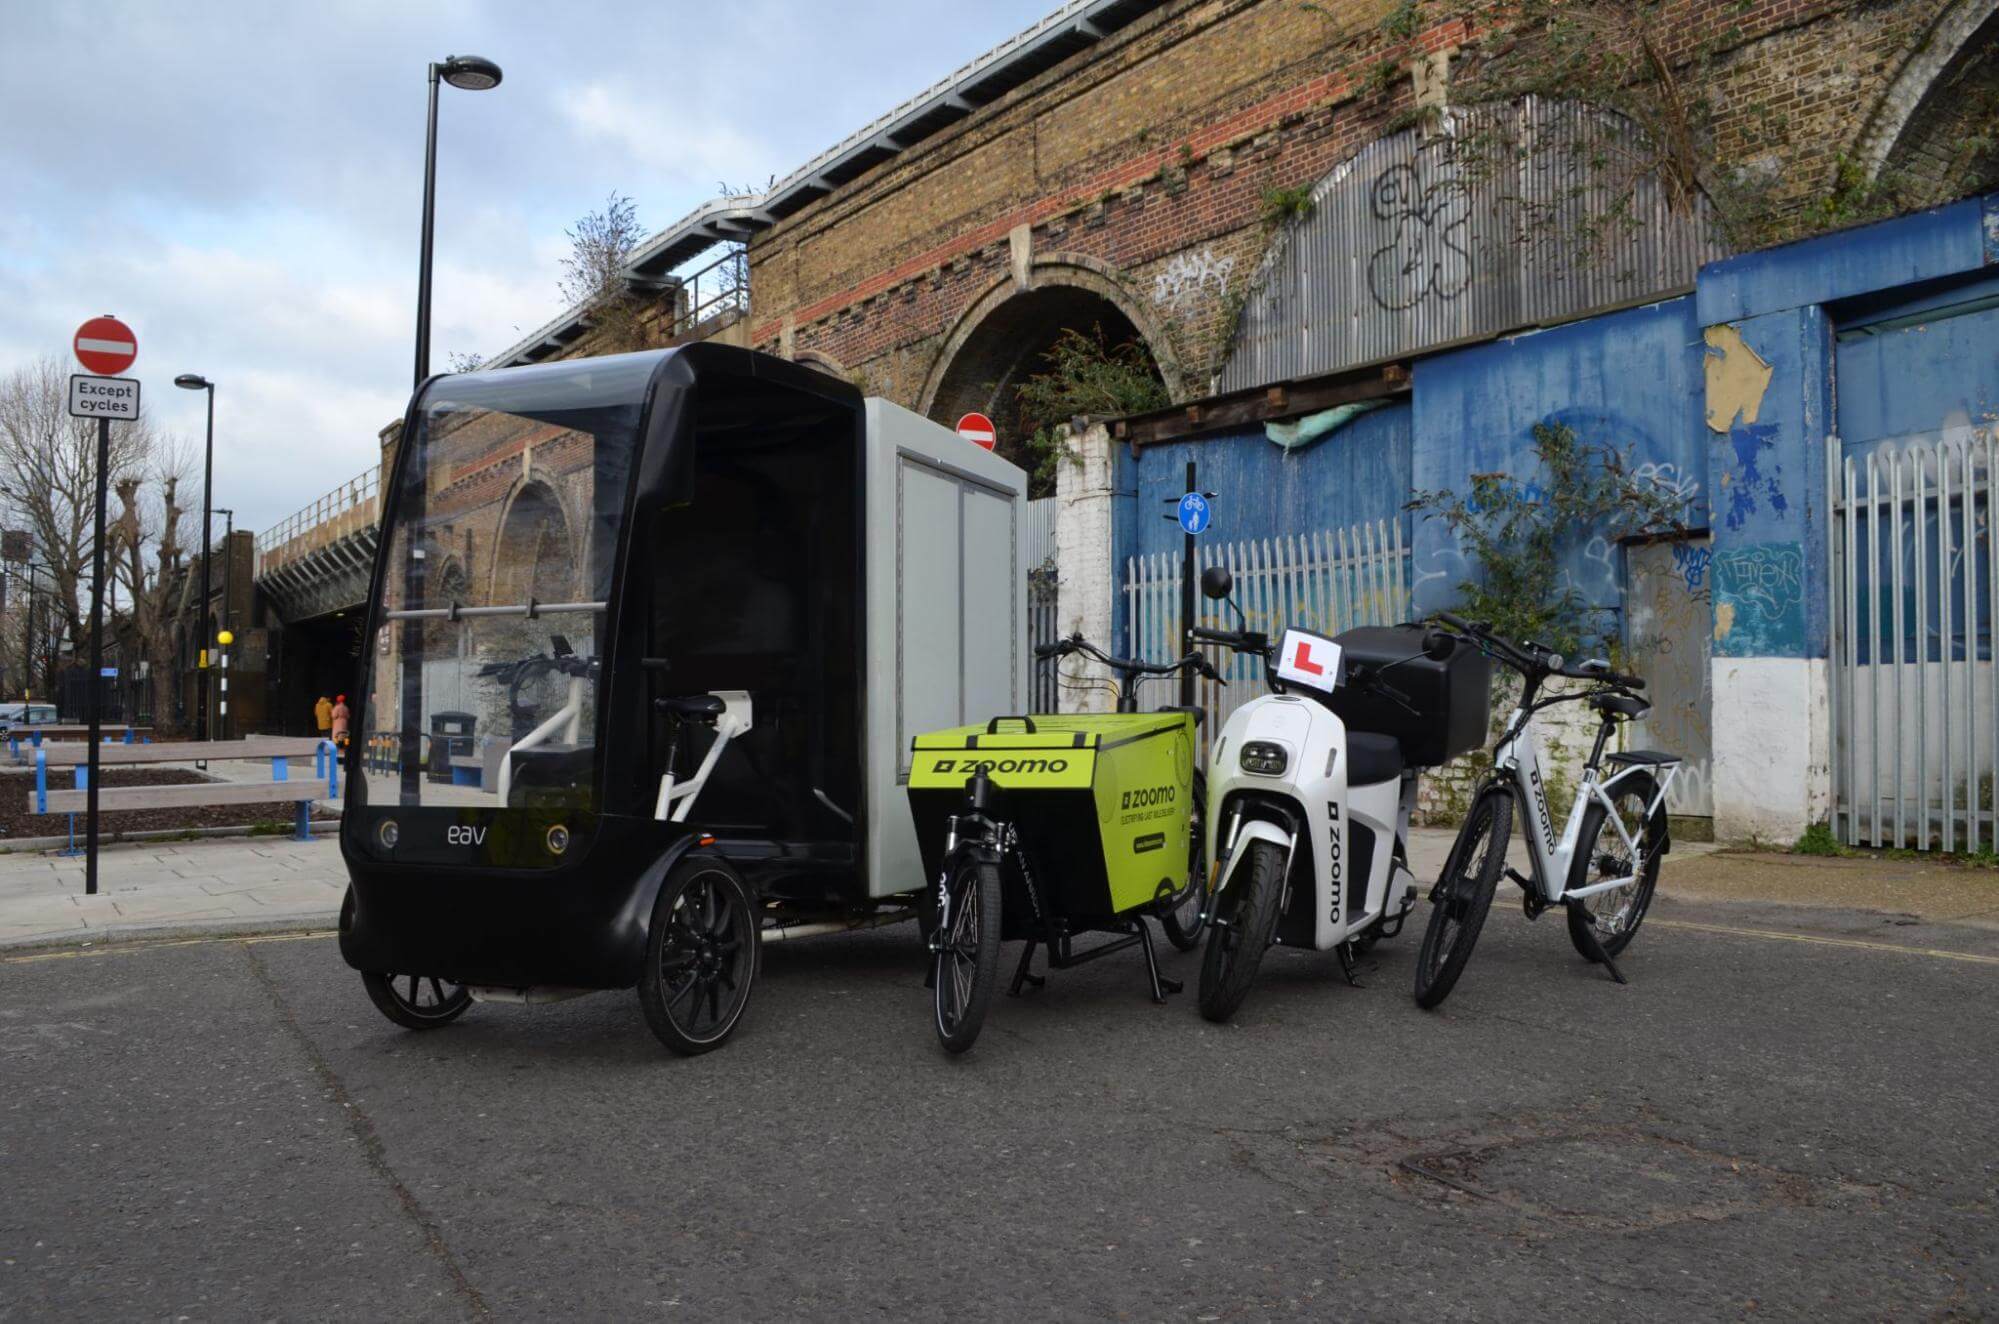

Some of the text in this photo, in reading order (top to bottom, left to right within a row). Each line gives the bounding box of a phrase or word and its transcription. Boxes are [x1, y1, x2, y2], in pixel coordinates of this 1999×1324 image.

[79, 382, 132, 398] Except
[80, 399, 129, 412] cycles
[1293, 641, 1324, 676] L
[958, 759, 1068, 773] zoomo
[1132, 785, 1175, 808] zoomo
[1534, 787, 1555, 856] zoomo
[447, 825, 487, 845] eav
[1329, 826, 1341, 924] zoomo
